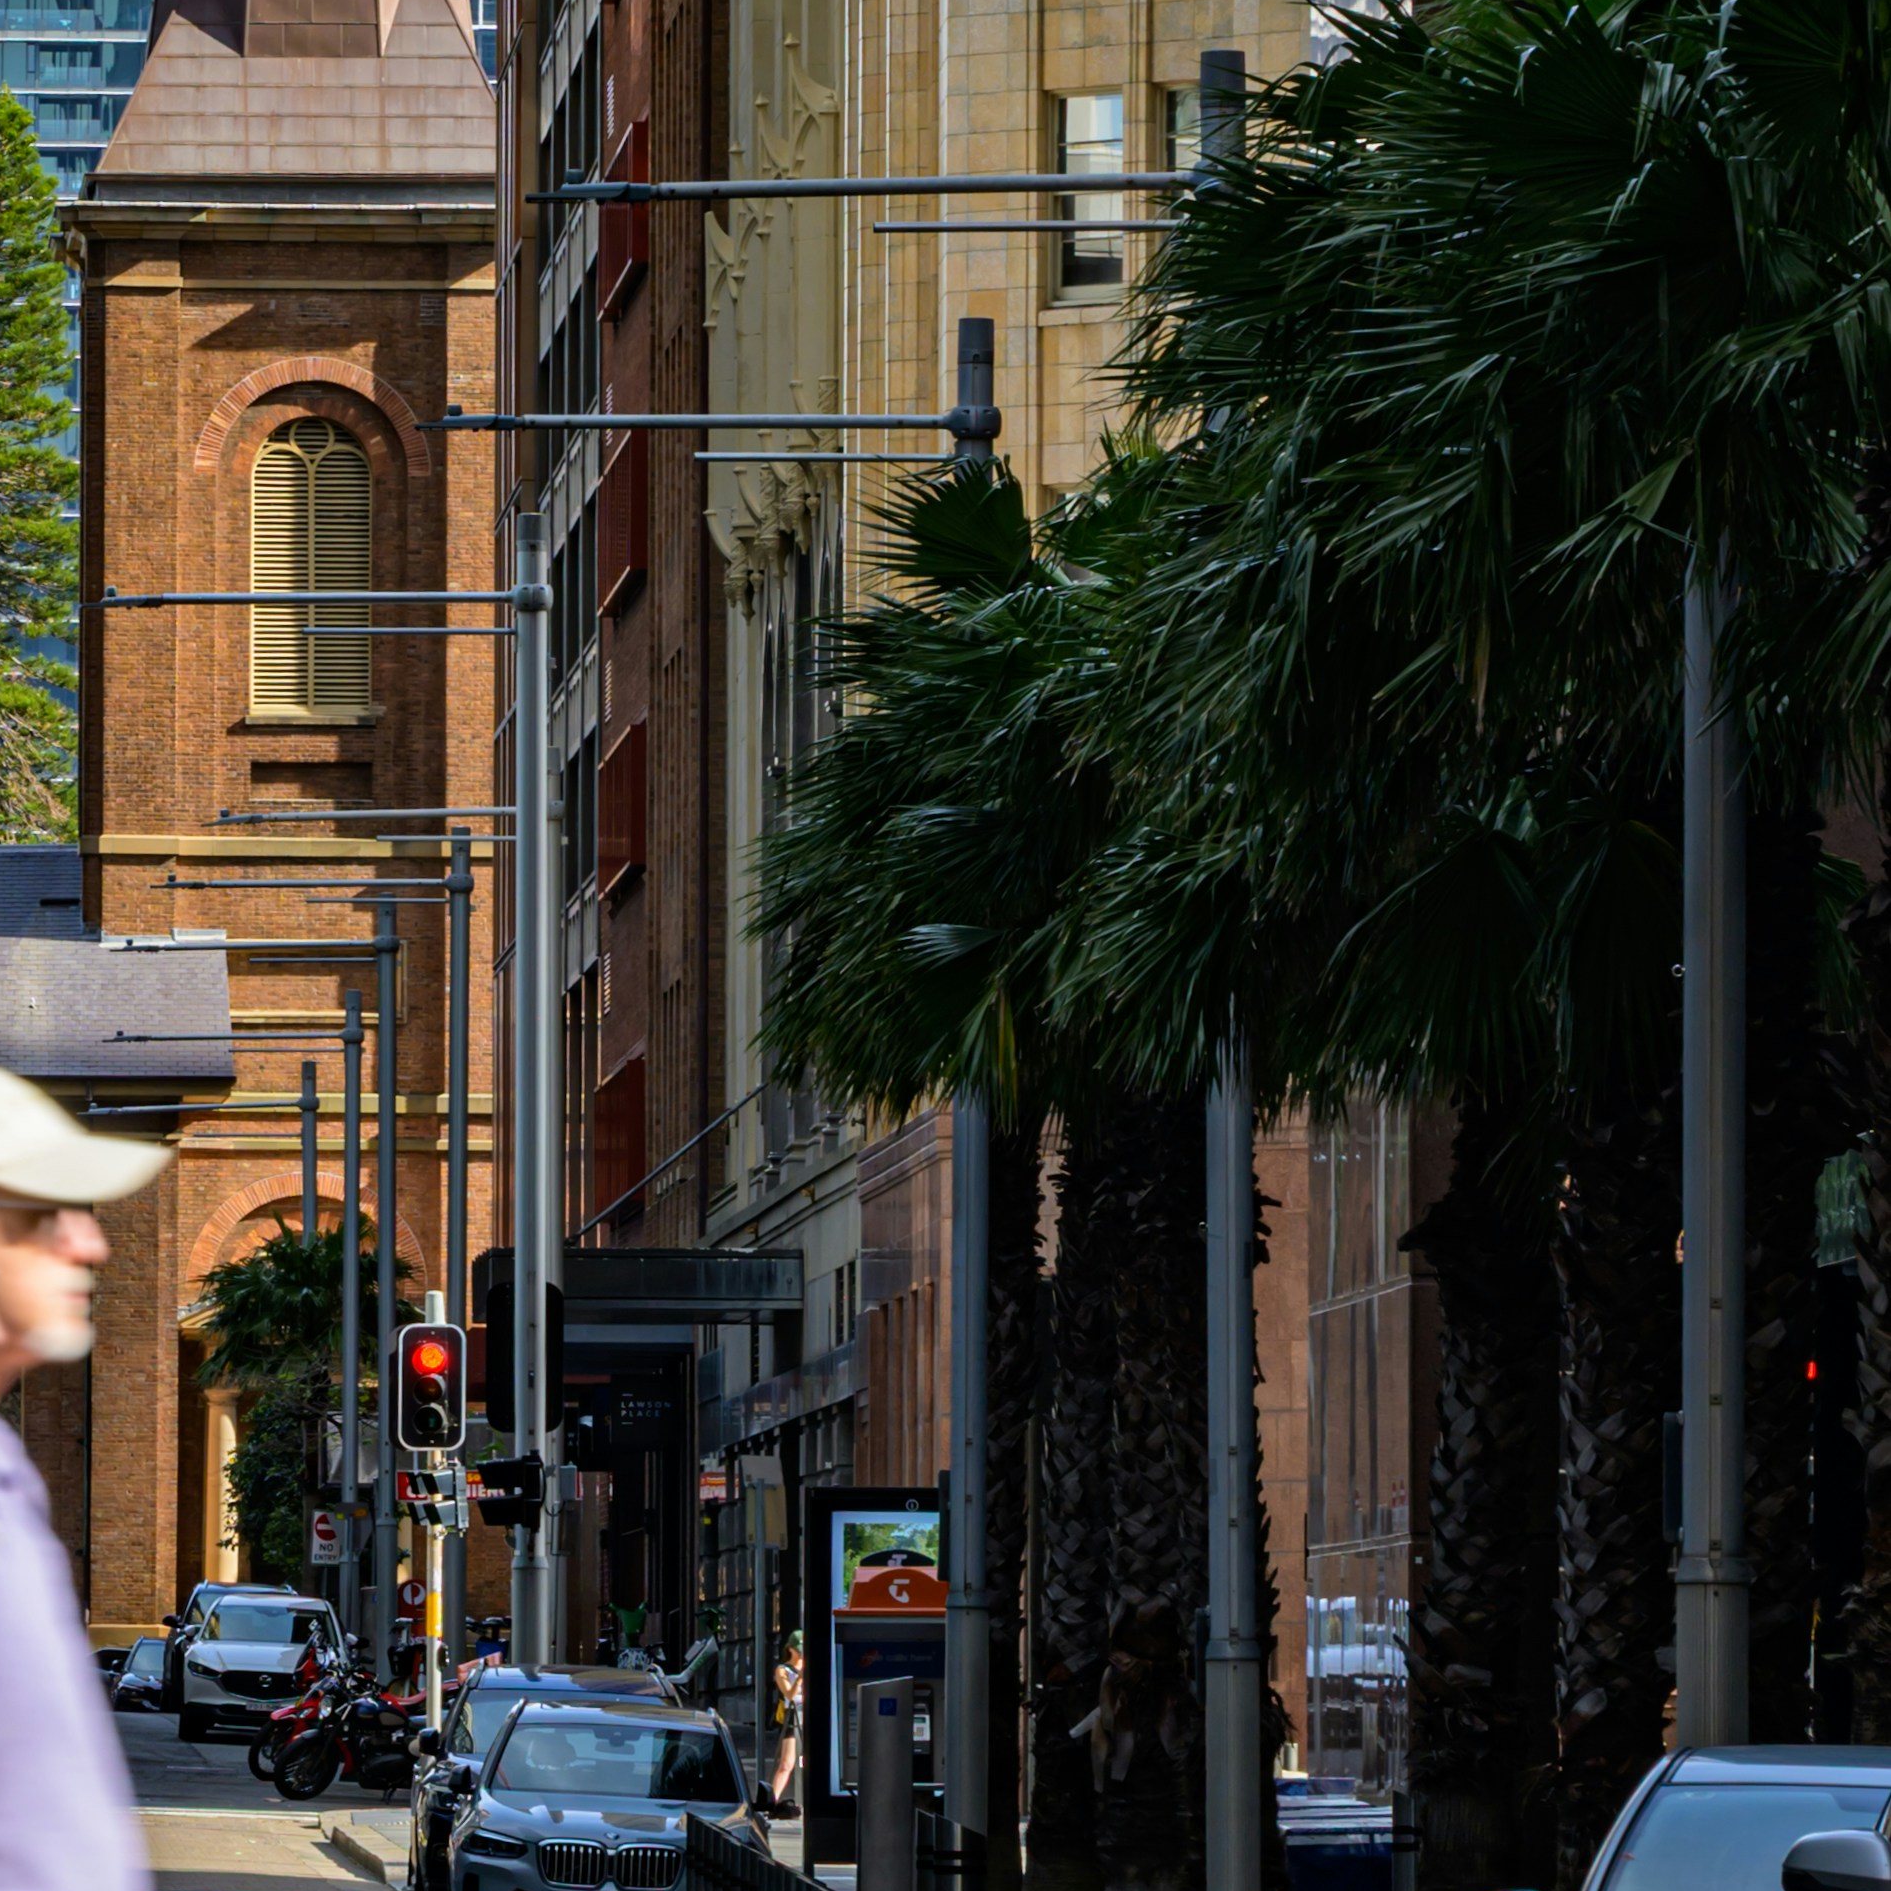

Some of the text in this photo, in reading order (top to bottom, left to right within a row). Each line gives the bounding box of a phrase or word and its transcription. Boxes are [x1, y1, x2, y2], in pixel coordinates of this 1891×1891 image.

[620, 1400, 672, 1409] LAWSON
[620, 1409, 662, 1418] PLACE
[319, 1543, 334, 1552] NO
[314, 1553, 337, 1561] ENTRY
